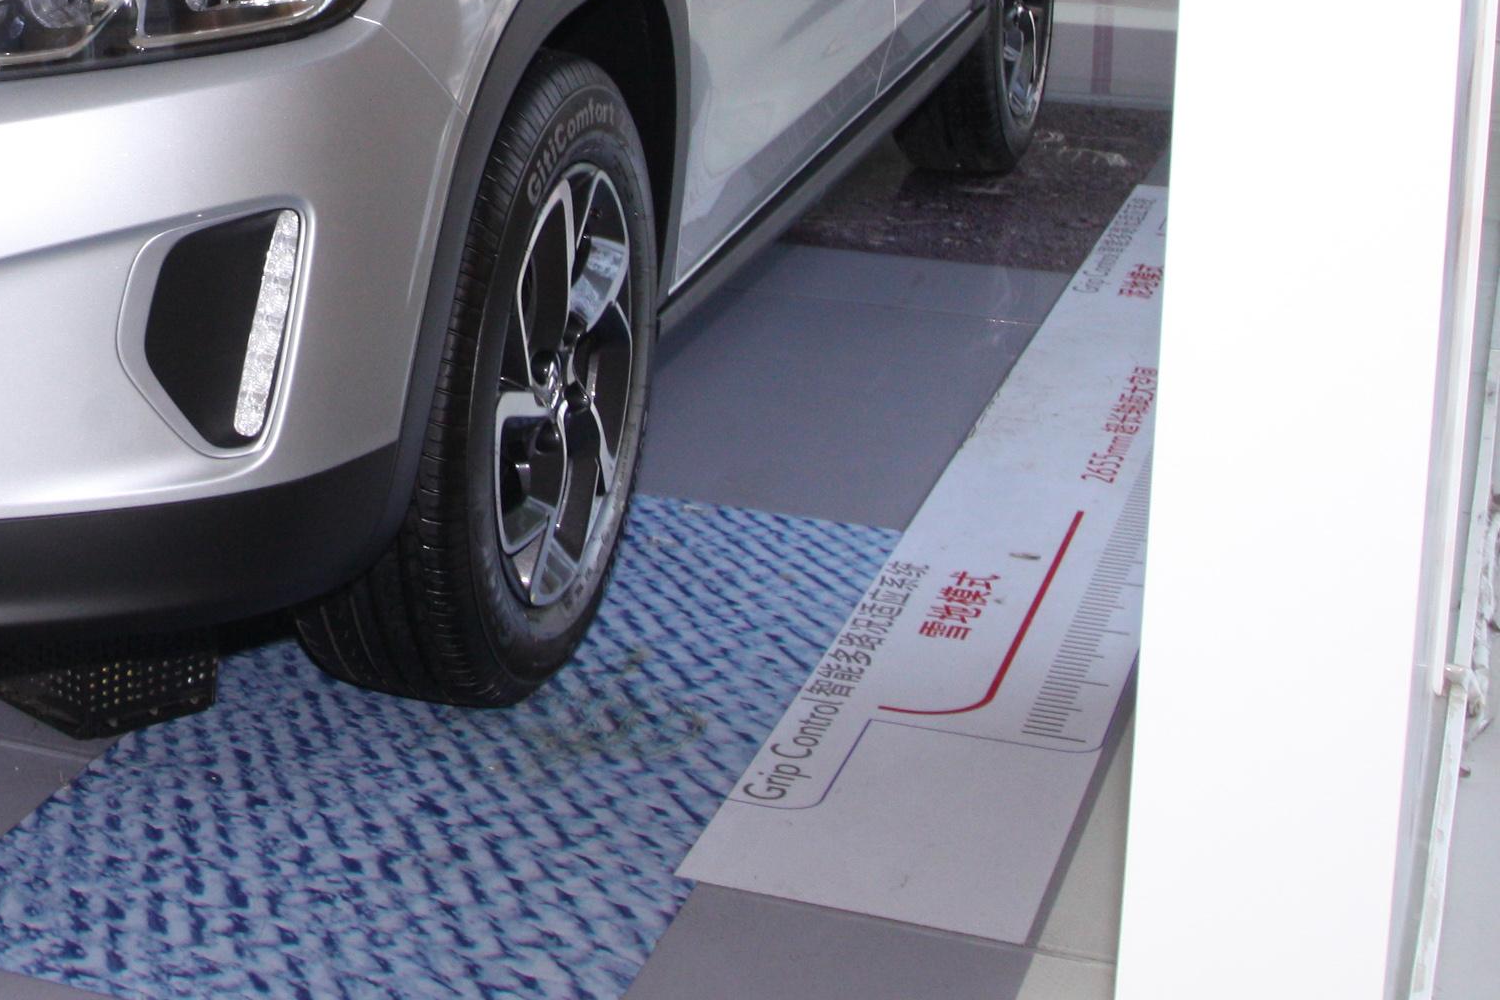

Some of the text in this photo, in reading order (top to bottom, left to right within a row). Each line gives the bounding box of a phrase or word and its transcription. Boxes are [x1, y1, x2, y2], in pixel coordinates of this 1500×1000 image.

[743, 560, 930, 801] Grip Control 智能多路况适应系统
[918, 569, 1001, 641] 雪地模式
